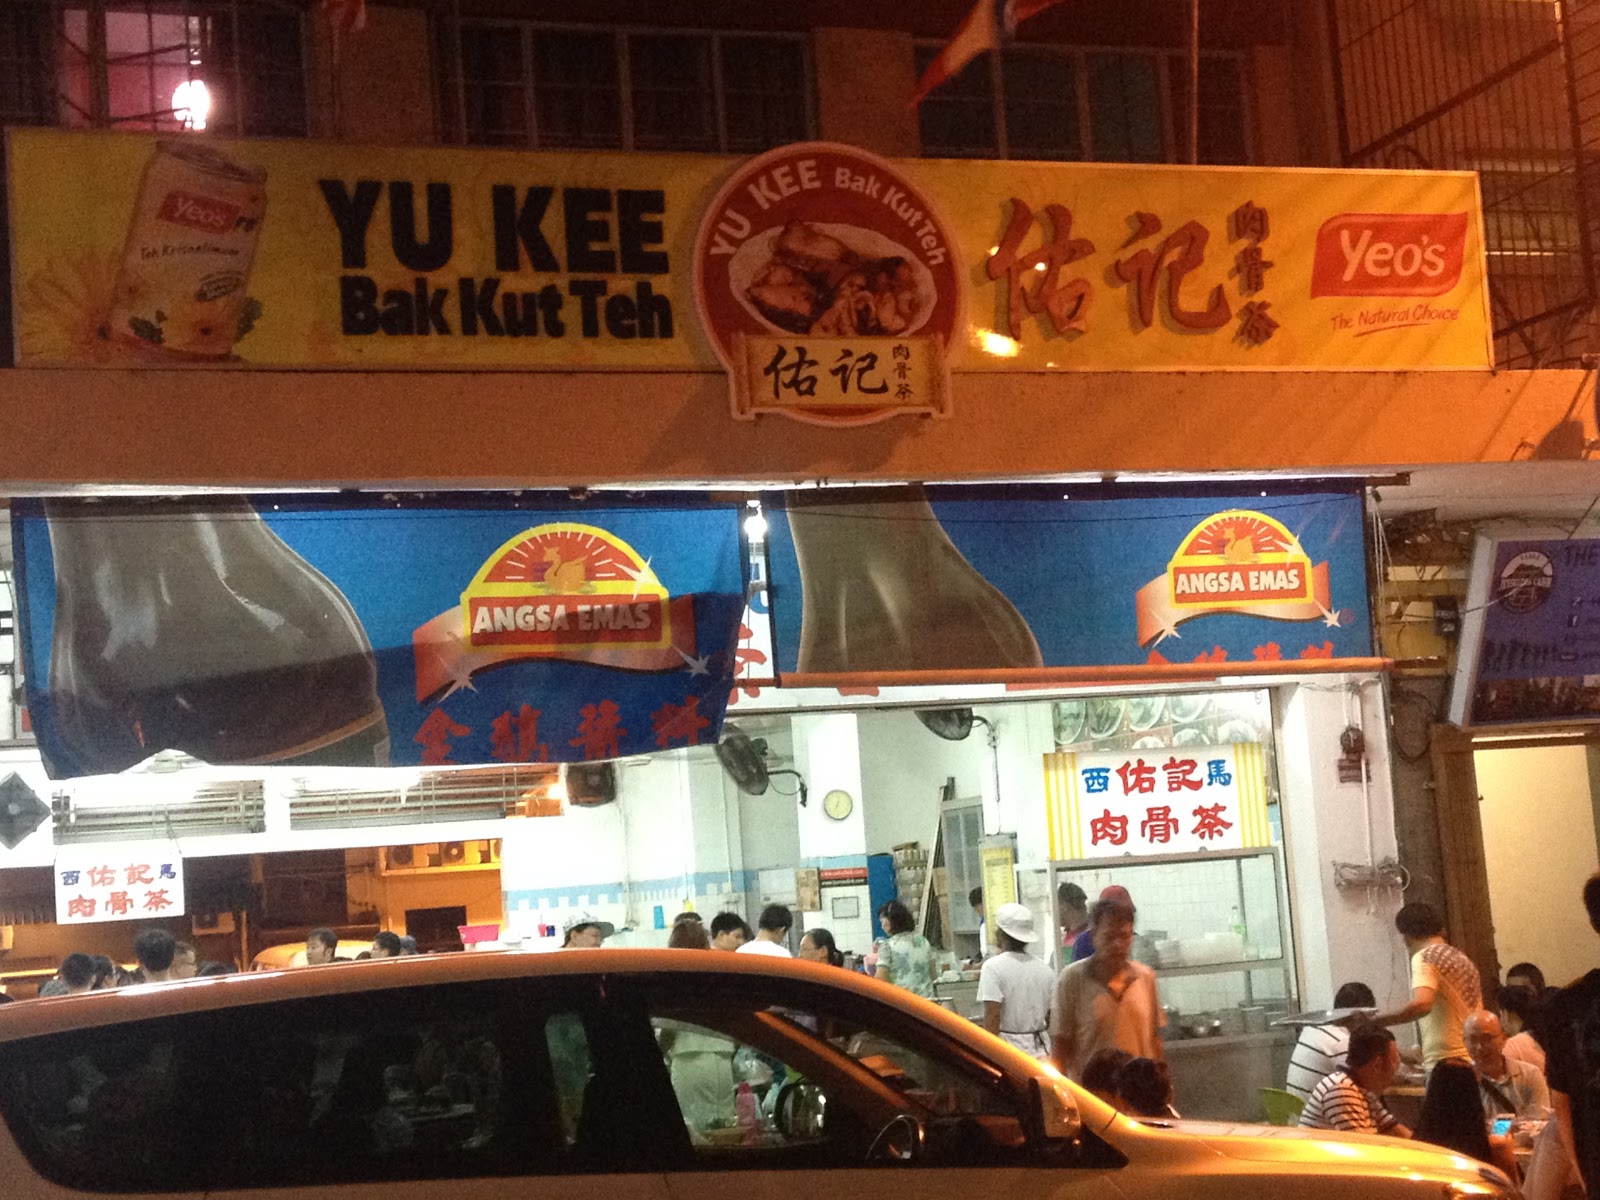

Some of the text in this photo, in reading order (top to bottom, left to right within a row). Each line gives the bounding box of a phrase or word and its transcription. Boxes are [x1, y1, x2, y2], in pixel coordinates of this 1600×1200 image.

[318, 179, 670, 275] YU KEE
[709, 159, 822, 256] YU KEE
[834, 167, 946, 266] Bak Kut Teh
[985, 198, 1232, 341] 佑记
[1229, 200, 1281, 348] 肉骨茶
[1340, 229, 1447, 282] Yeo's
[341, 276, 675, 340] Bak Kut Teh
[1331, 304, 1460, 331] The Natural Choice
[763, 344, 889, 400] 佑记
[892, 344, 914, 400] 肉骨茶
[1175, 569, 1300, 595] ANGSA EMAS
[473, 604, 653, 634] ANGSA EMAS
[1090, 803, 1233, 846] 肉骨茶
[67, 889, 174, 918] 肉骨茶
